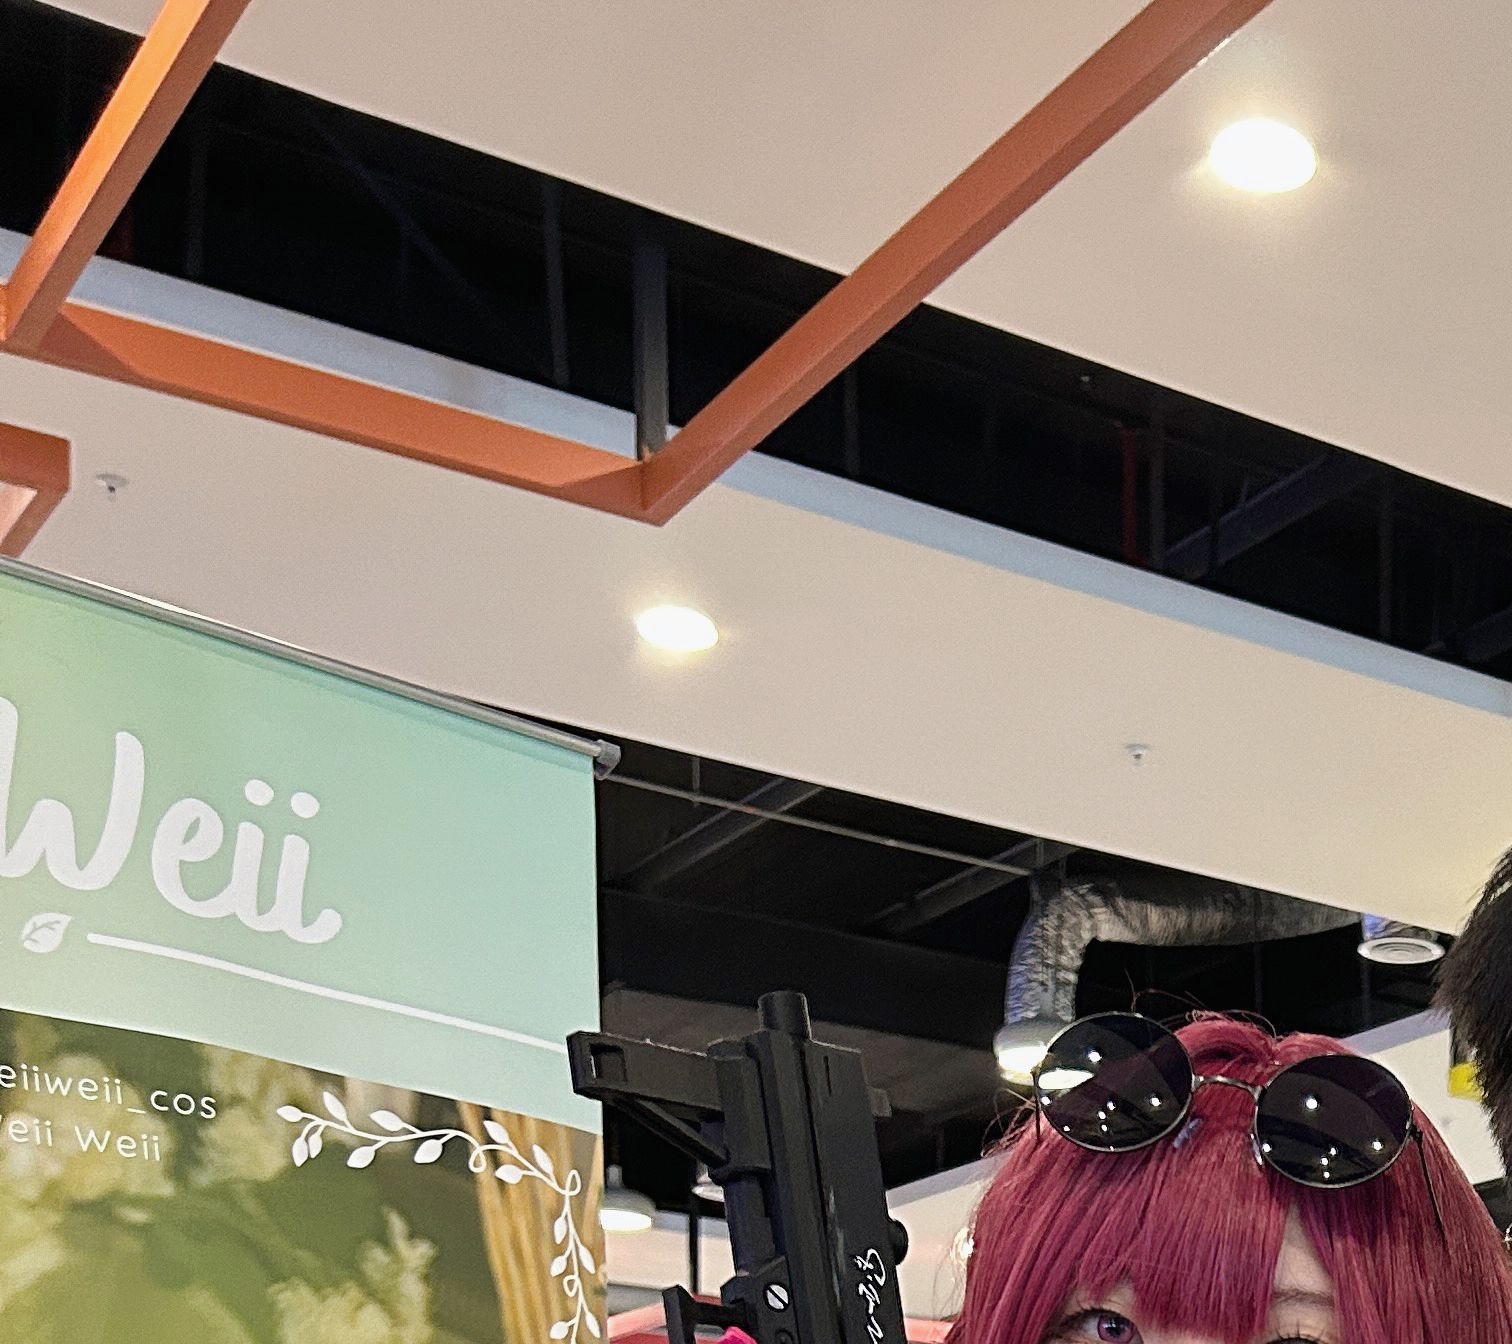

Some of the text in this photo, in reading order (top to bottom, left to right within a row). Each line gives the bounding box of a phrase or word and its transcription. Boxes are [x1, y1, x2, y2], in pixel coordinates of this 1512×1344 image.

[0, 695, 343, 944] Weii
[0, 1114, 161, 1161] eii Weii
